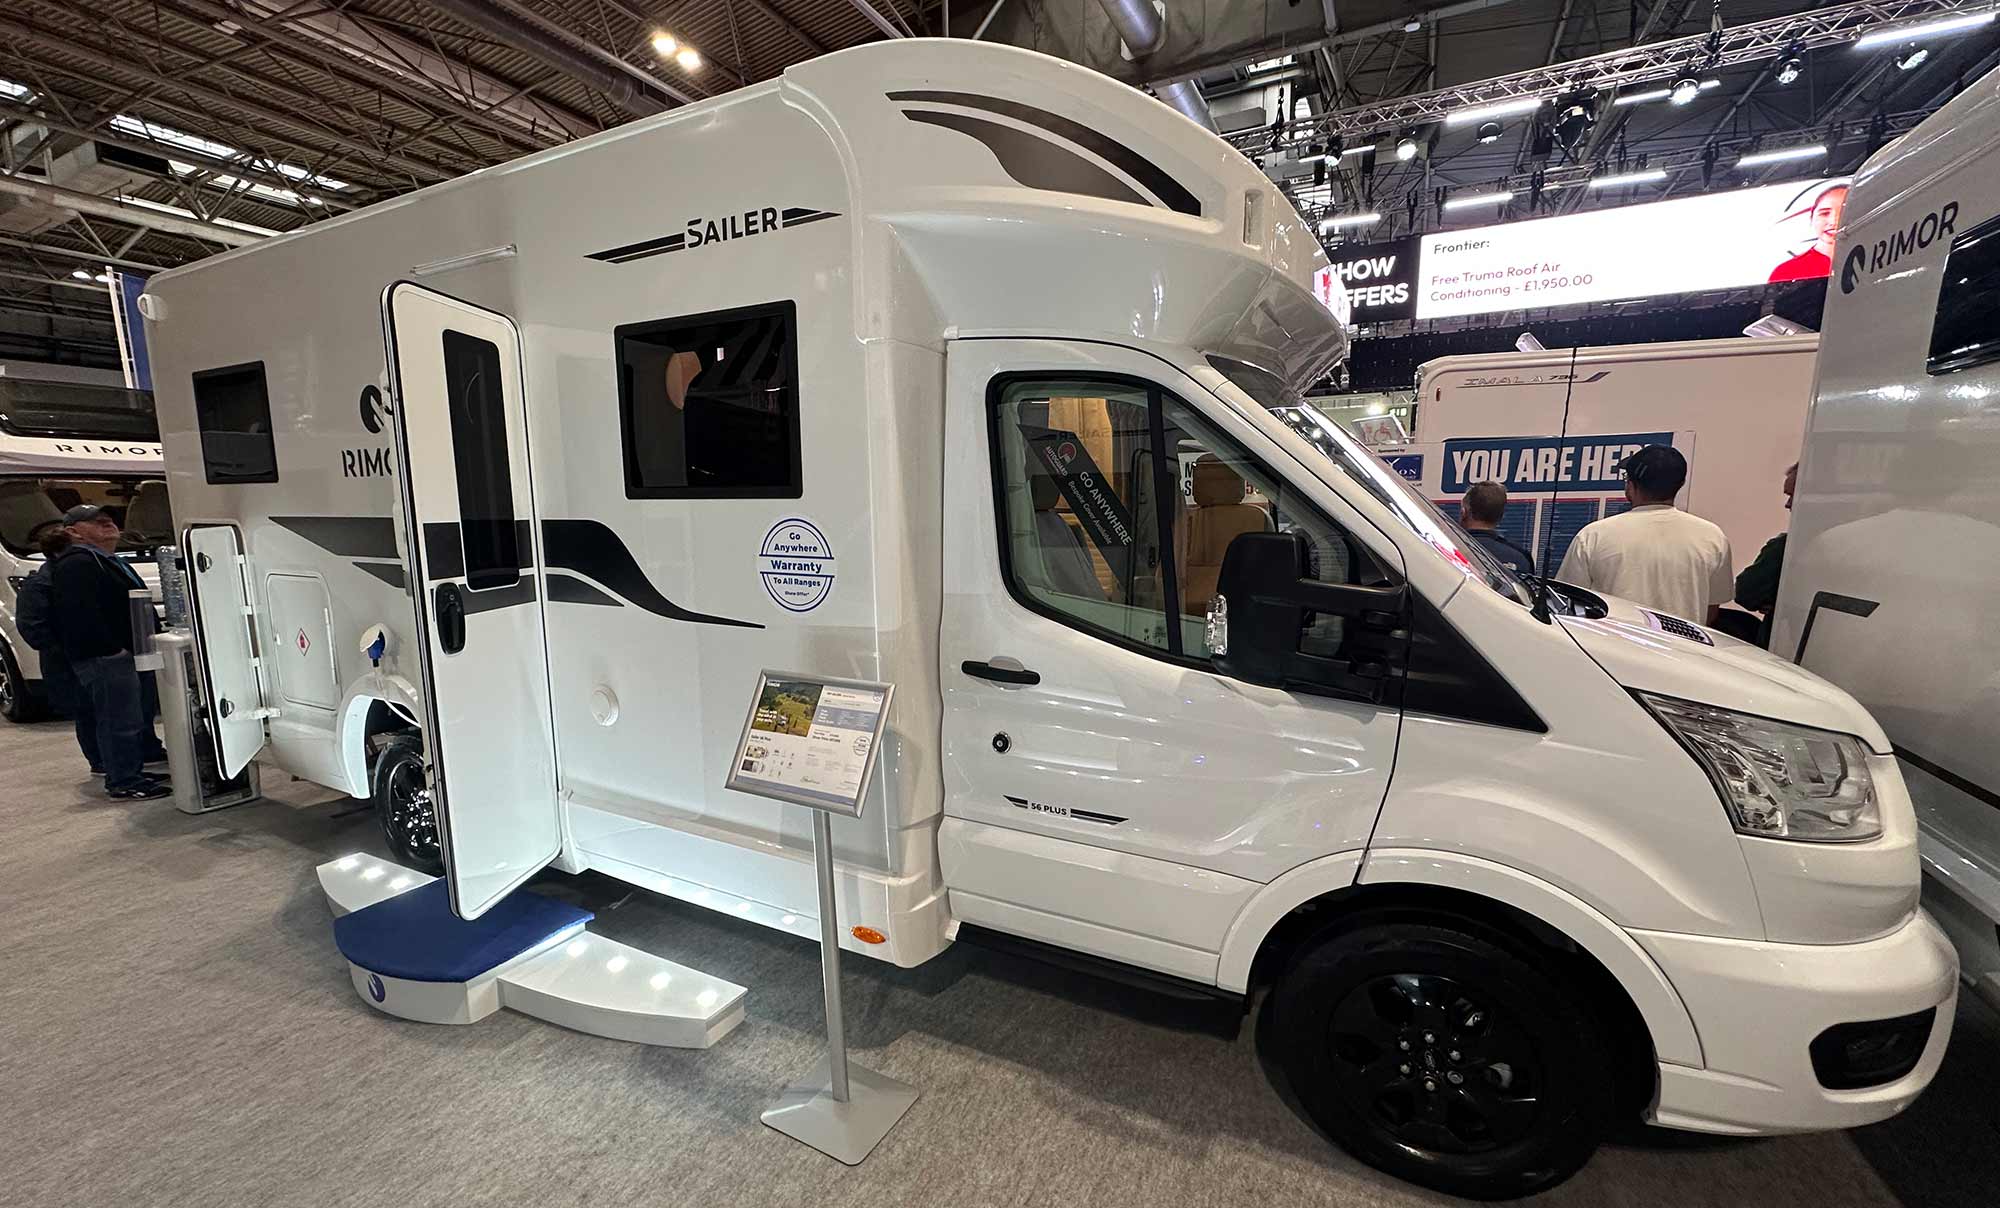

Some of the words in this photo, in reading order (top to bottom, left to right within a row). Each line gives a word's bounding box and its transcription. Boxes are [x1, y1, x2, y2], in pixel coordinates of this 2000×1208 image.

[687, 206, 778, 249] SAILER
[1870, 201, 1959, 274] RIMOR
[1433, 239, 1490, 255] Frontier:
[1333, 256, 1396, 281] HOW
[1431, 275, 1460, 287] Free
[1464, 270, 1504, 283] Truma
[1507, 264, 1538, 278] Roof
[1541, 262, 1561, 273] Air
[1344, 283, 1409, 308] FFERS
[1430, 284, 1511, 302] Conditioning
[341, 447, 392, 478] RIM
[1452, 449, 1510, 485] YOU
[1514, 446, 1574, 483] ARE
[1579, 443, 1652, 481] HE
[1080, 471, 1094, 488] GO
[1089, 487, 1133, 546] ANYWHERE
[1083, 503, 1097, 520] Cover
[789, 532, 801, 541] Go
[774, 543, 818, 553] Anywhere
[770, 560, 822, 573] Warranty
[773, 577, 783, 585] To
[782, 577, 793, 586] All
[794, 578, 821, 588] Ranges
[1043, 805, 1068, 816] PLUS
